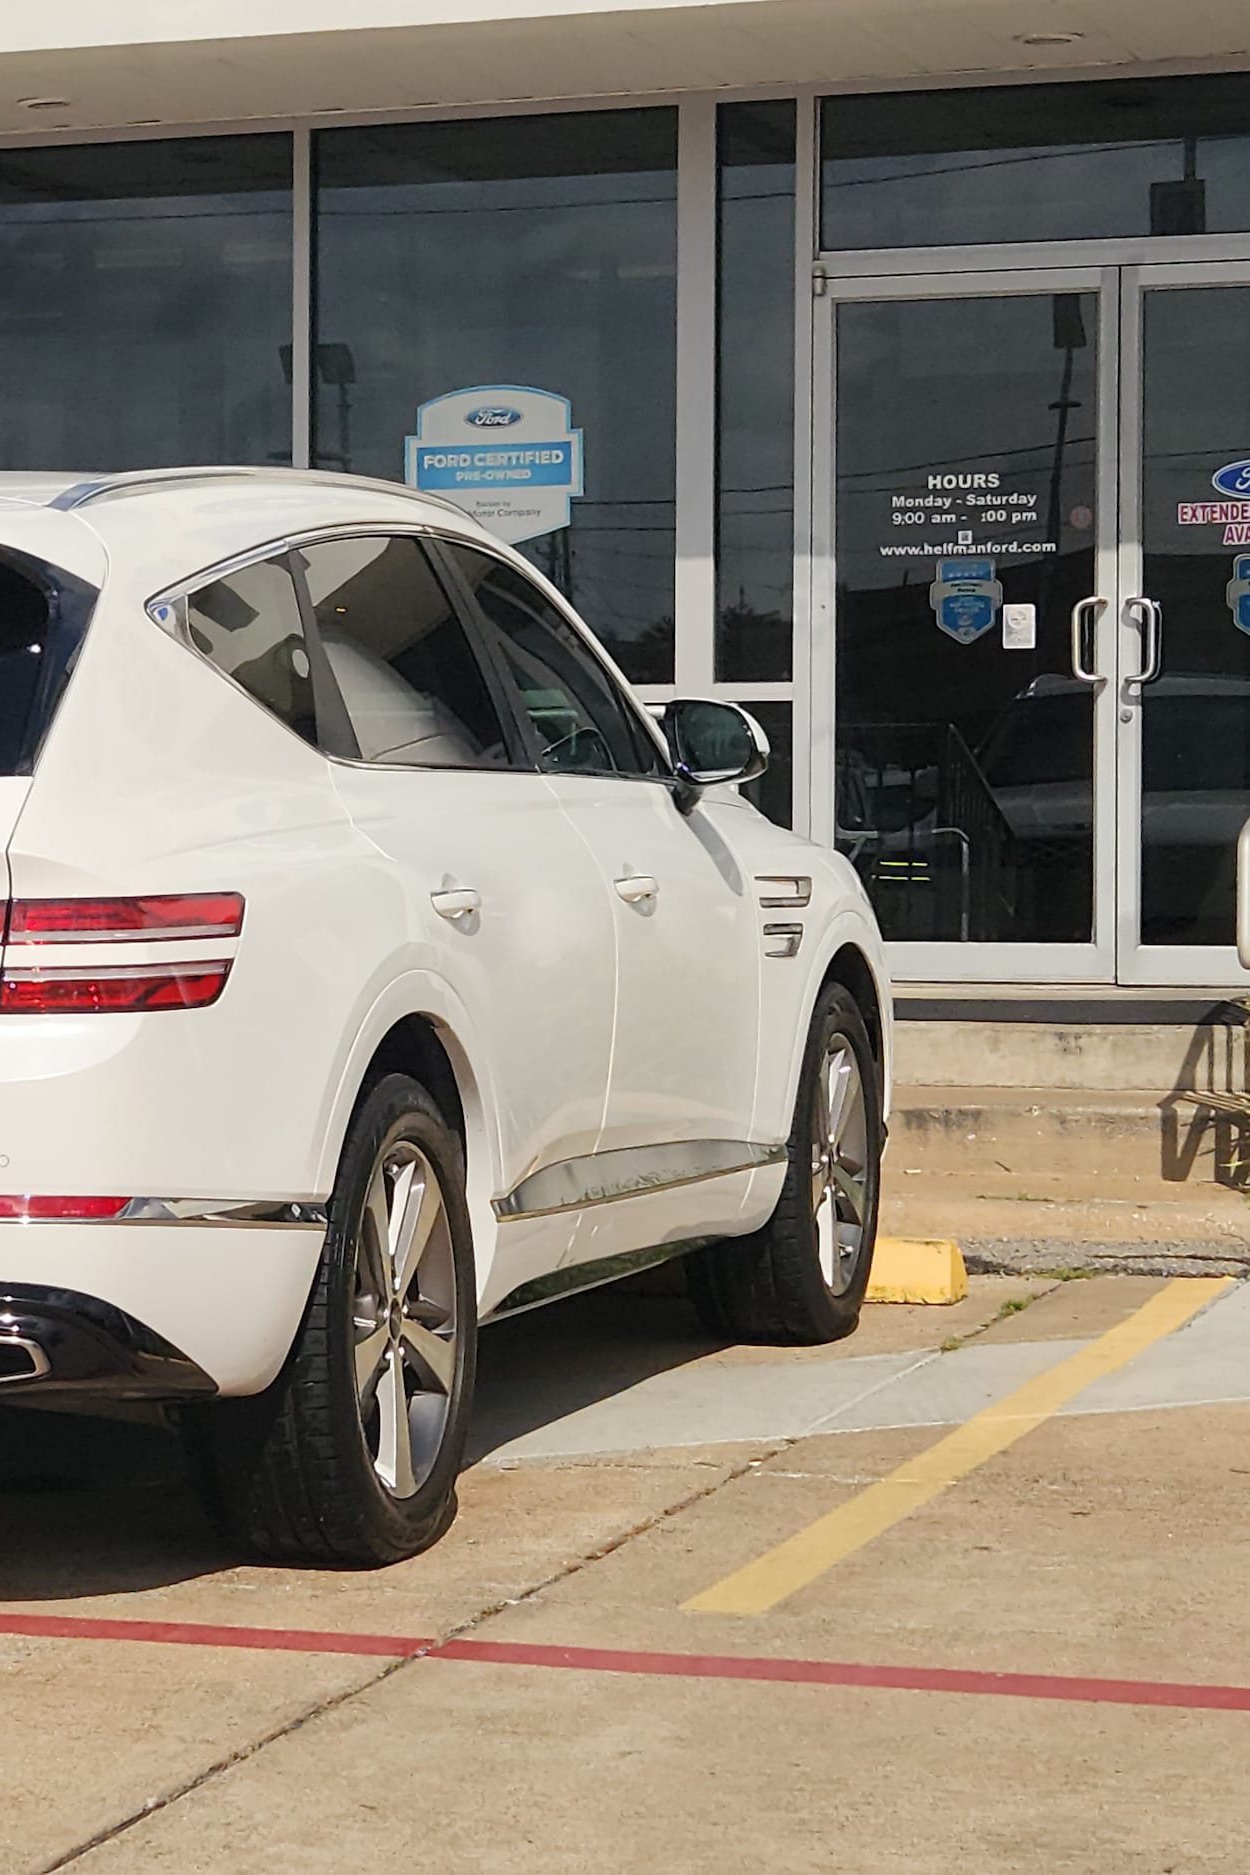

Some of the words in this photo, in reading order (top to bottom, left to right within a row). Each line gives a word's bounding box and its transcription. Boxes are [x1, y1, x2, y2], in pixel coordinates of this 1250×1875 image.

[475, 408, 511, 425] Ford
[423, 453, 471, 470] FORD
[474, 450, 564, 466] CERTIFIED
[455, 469, 531, 481] PRE-OWNED
[927, 473, 1000, 490] HOURS
[891, 495, 952, 509] Monday
[965, 493, 1038, 507] Saturday
[931, 514, 957, 524] am
[1011, 511, 1038, 524] pm
[880, 541, 1057, 556] www.helfmanford.com
